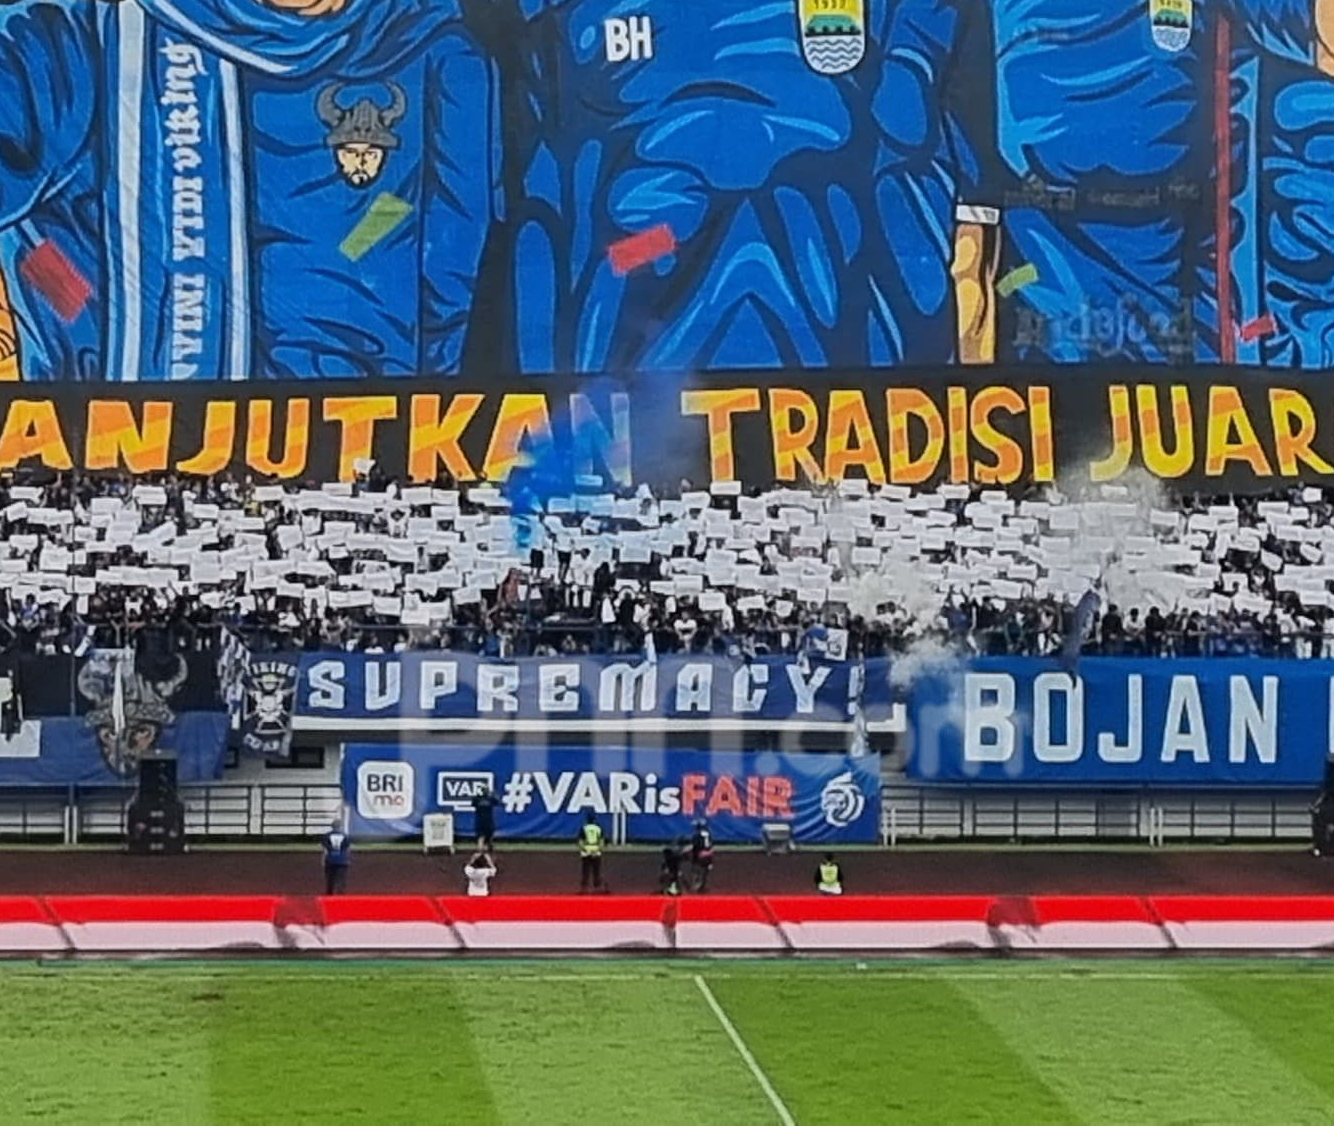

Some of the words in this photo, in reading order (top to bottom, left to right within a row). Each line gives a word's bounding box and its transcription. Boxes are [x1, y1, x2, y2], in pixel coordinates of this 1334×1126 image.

[604, 15, 654, 62] BH
[680, 385, 1055, 486] TRADISI
[307, 660, 864, 716] SUPREMACY!
[963, 671, 1279, 765] BOJAN
[366, 773, 405, 793] BRI
[445, 780, 486, 797] VAR
[502, 770, 797, 818] #VARisFAIR
